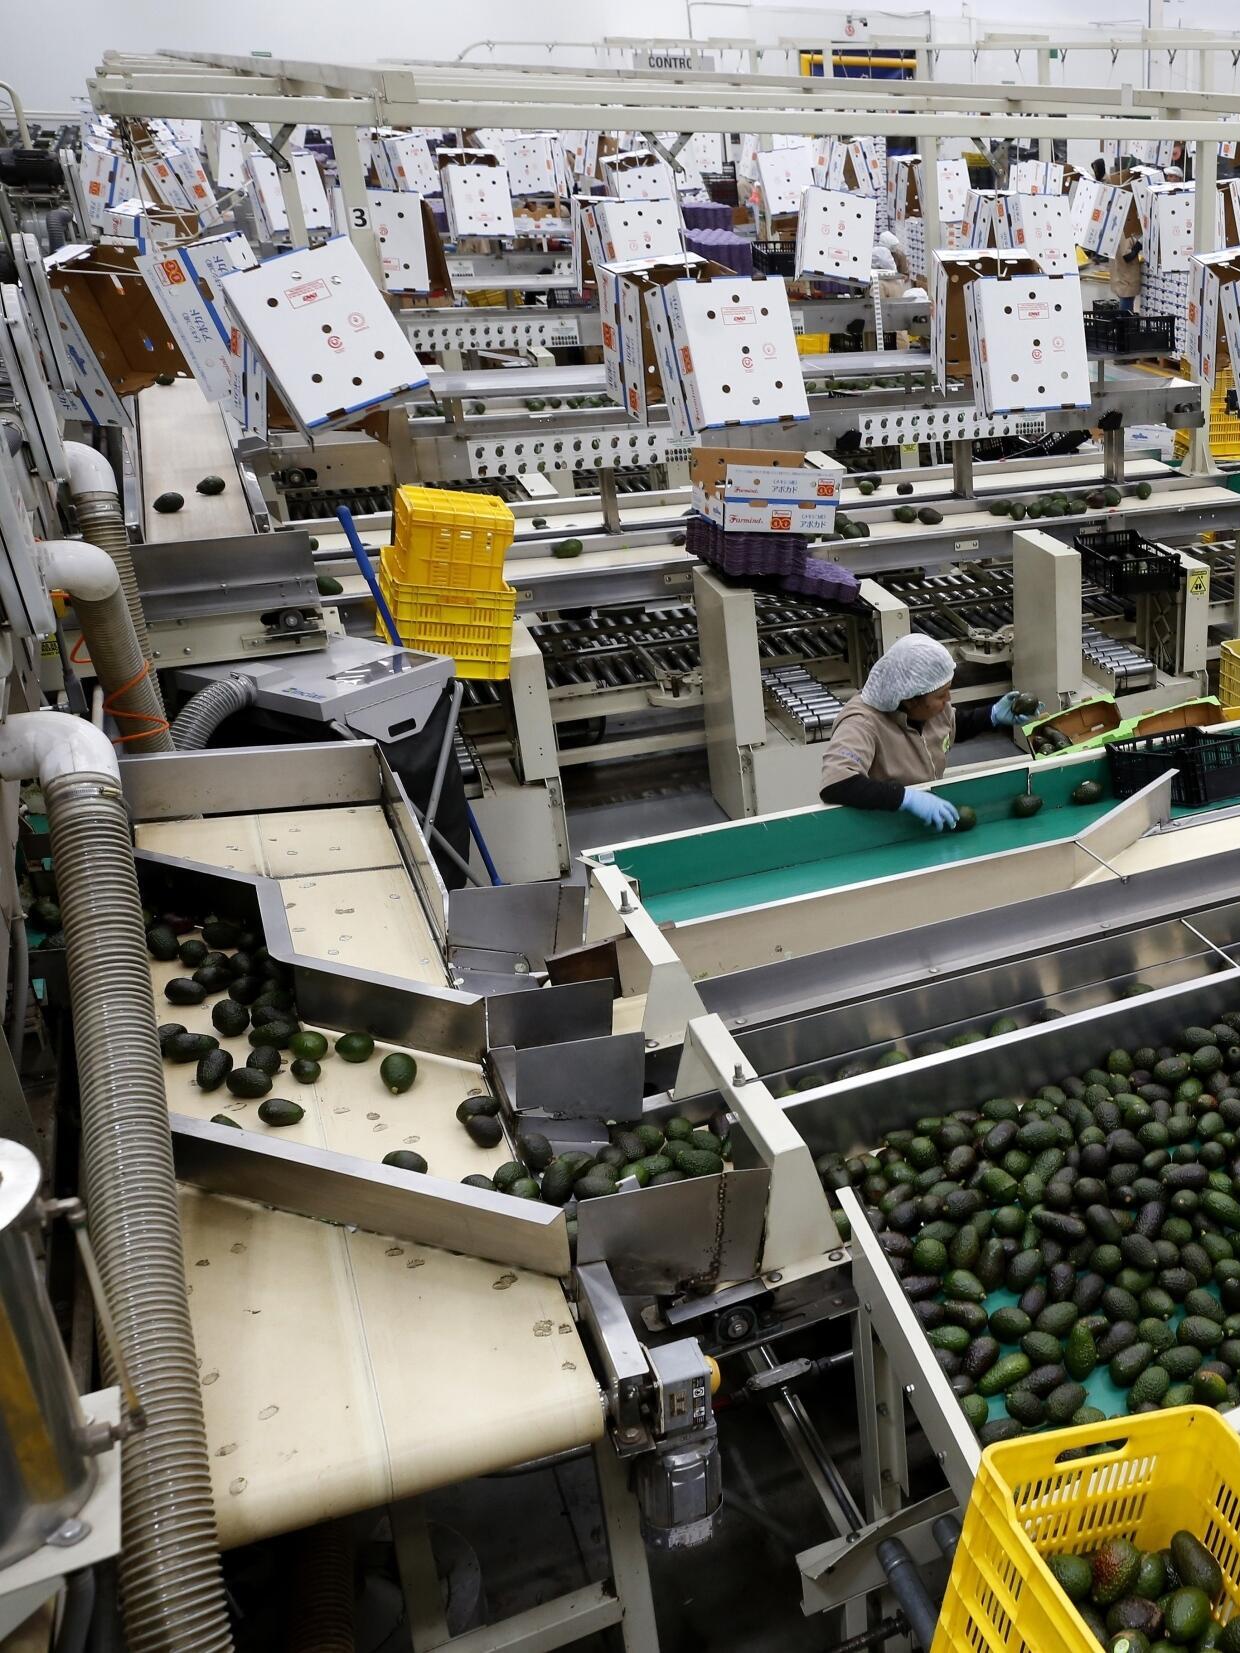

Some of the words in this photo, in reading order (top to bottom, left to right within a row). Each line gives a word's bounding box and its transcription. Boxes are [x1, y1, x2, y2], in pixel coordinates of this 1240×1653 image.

[352, 208, 367, 227] 3
[771, 486, 799, 494] アボカド
[800, 521, 827, 529] アボカド
